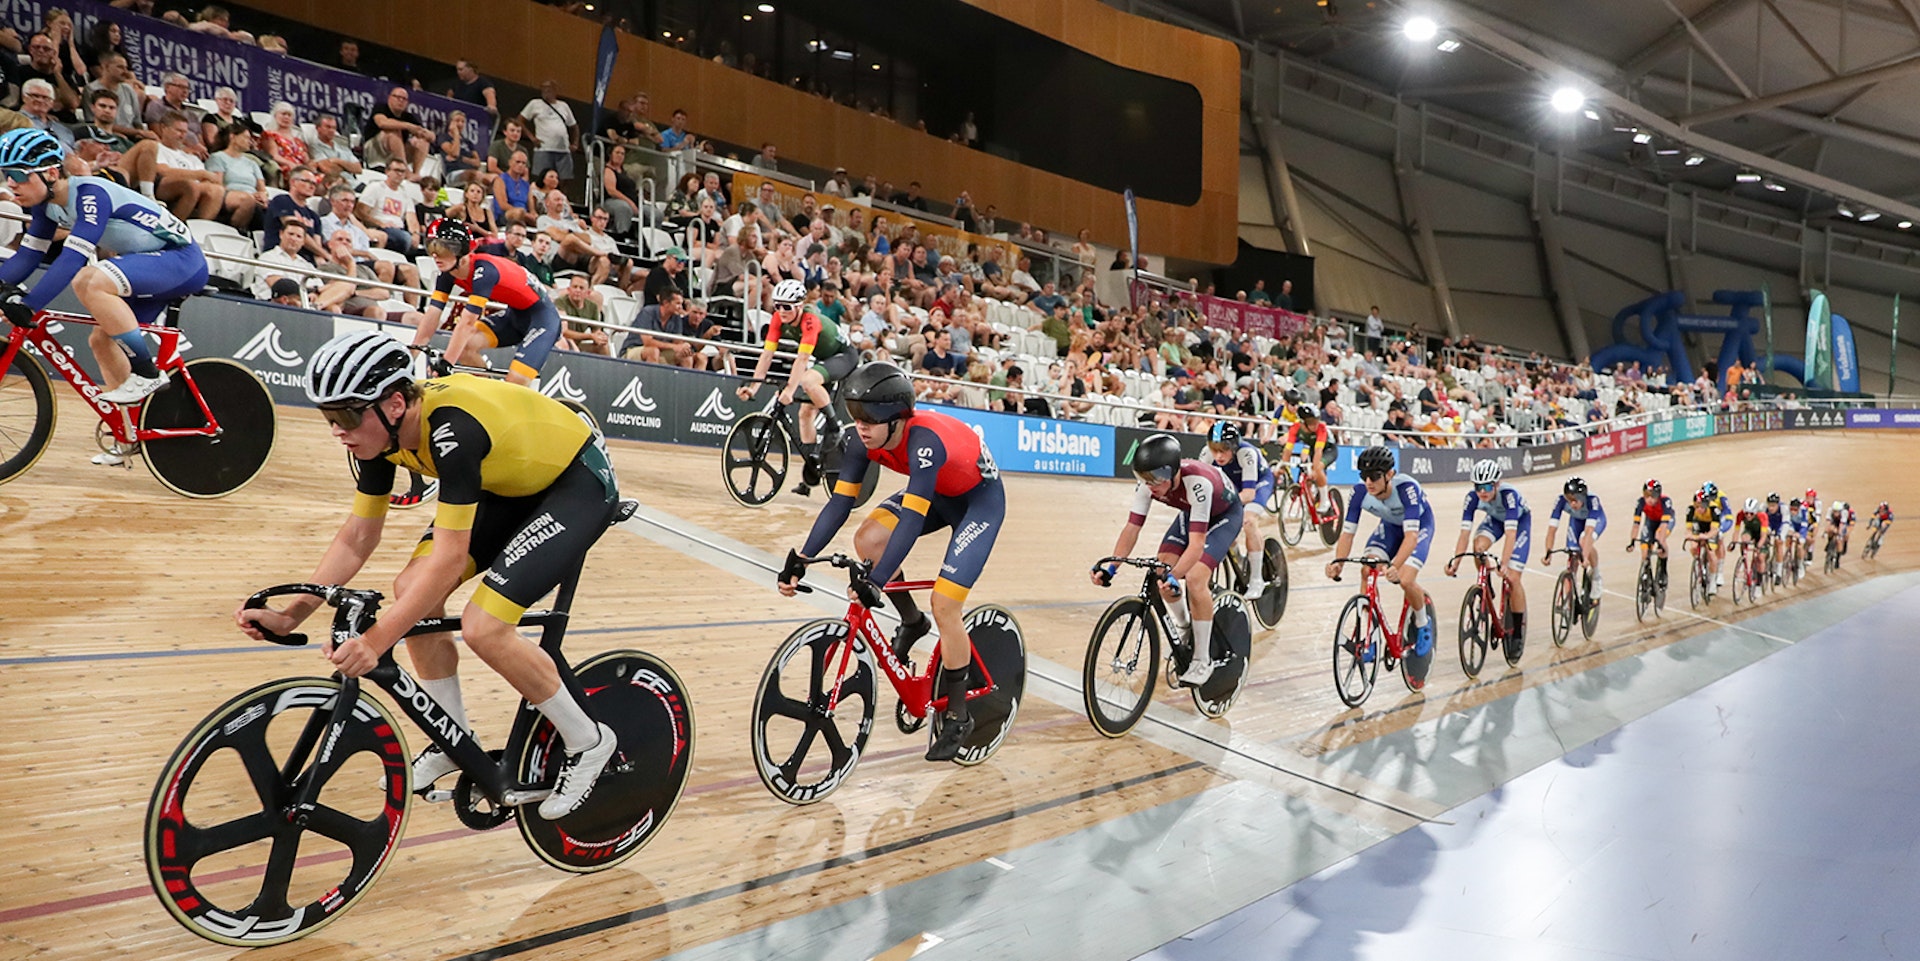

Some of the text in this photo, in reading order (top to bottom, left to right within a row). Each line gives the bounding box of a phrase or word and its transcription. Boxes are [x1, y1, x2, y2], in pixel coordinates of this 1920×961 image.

[144, 34, 249, 88] CYCLING
[284, 72, 374, 120] CYCLING
[82, 195, 98, 226] NSW
[41, 339, 114, 414] cervélo
[607, 412, 662, 428] AUSCYCLING
[432, 422, 460, 458] WA
[1017, 419, 1101, 458] brisbane
[917, 446, 933, 469] SA
[1034, 458, 1087, 473] australia
[1193, 483, 1206, 503] QLD
[503, 512, 554, 556] WESTERN
[504, 521, 567, 568] AUSTRALIA
[953, 521, 990, 557] AUSTRALIA
[954, 521, 978, 545] SOUTH
[415, 618, 442, 627] OLAN
[865, 618, 906, 681] cervélo
[392, 664, 464, 747] DOLAN
